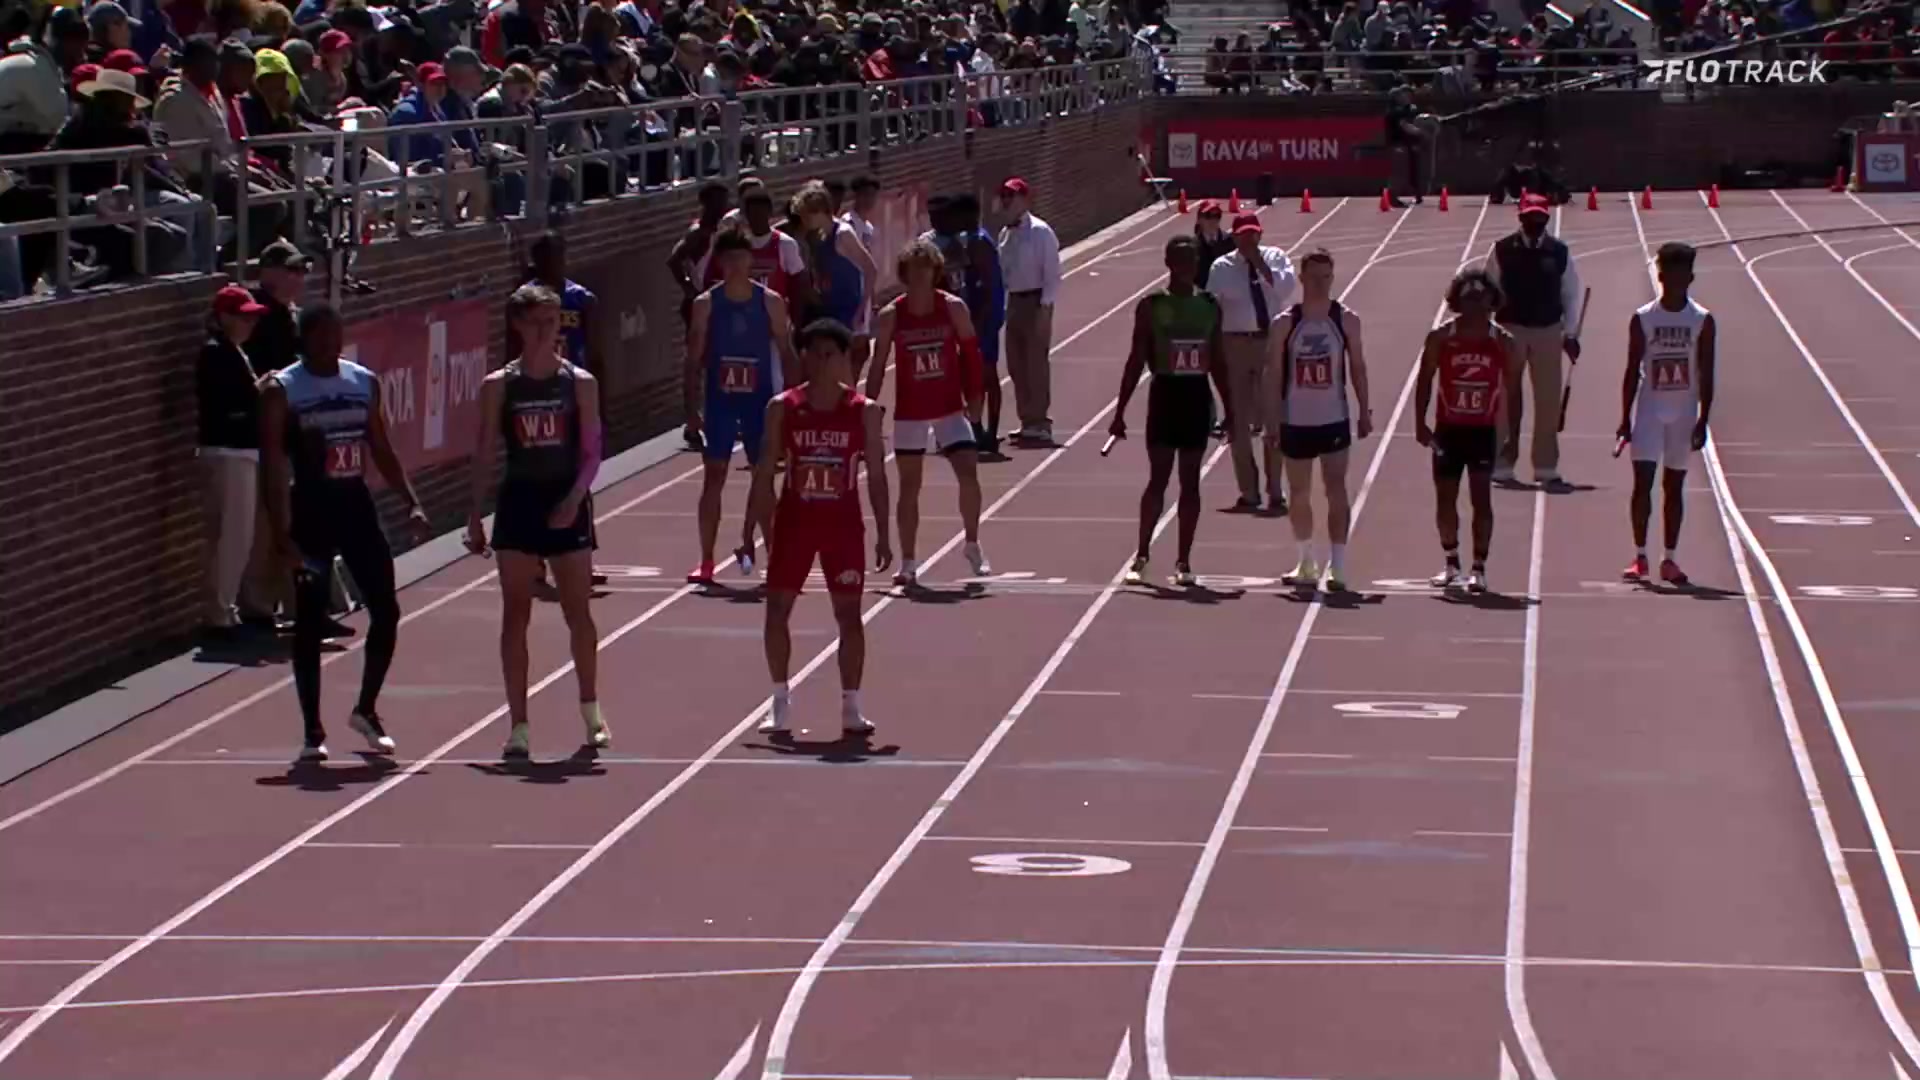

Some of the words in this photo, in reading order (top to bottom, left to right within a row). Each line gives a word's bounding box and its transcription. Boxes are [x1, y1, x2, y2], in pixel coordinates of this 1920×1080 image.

[1279, 138, 1338, 160] TURN
[916, 352, 939, 373] AH
[1451, 353, 1491, 368] OCEAN
[521, 415, 556, 438] WJ
[792, 430, 850, 448] WILSON
[335, 447, 362, 469] XH
[803, 467, 835, 492] AL
